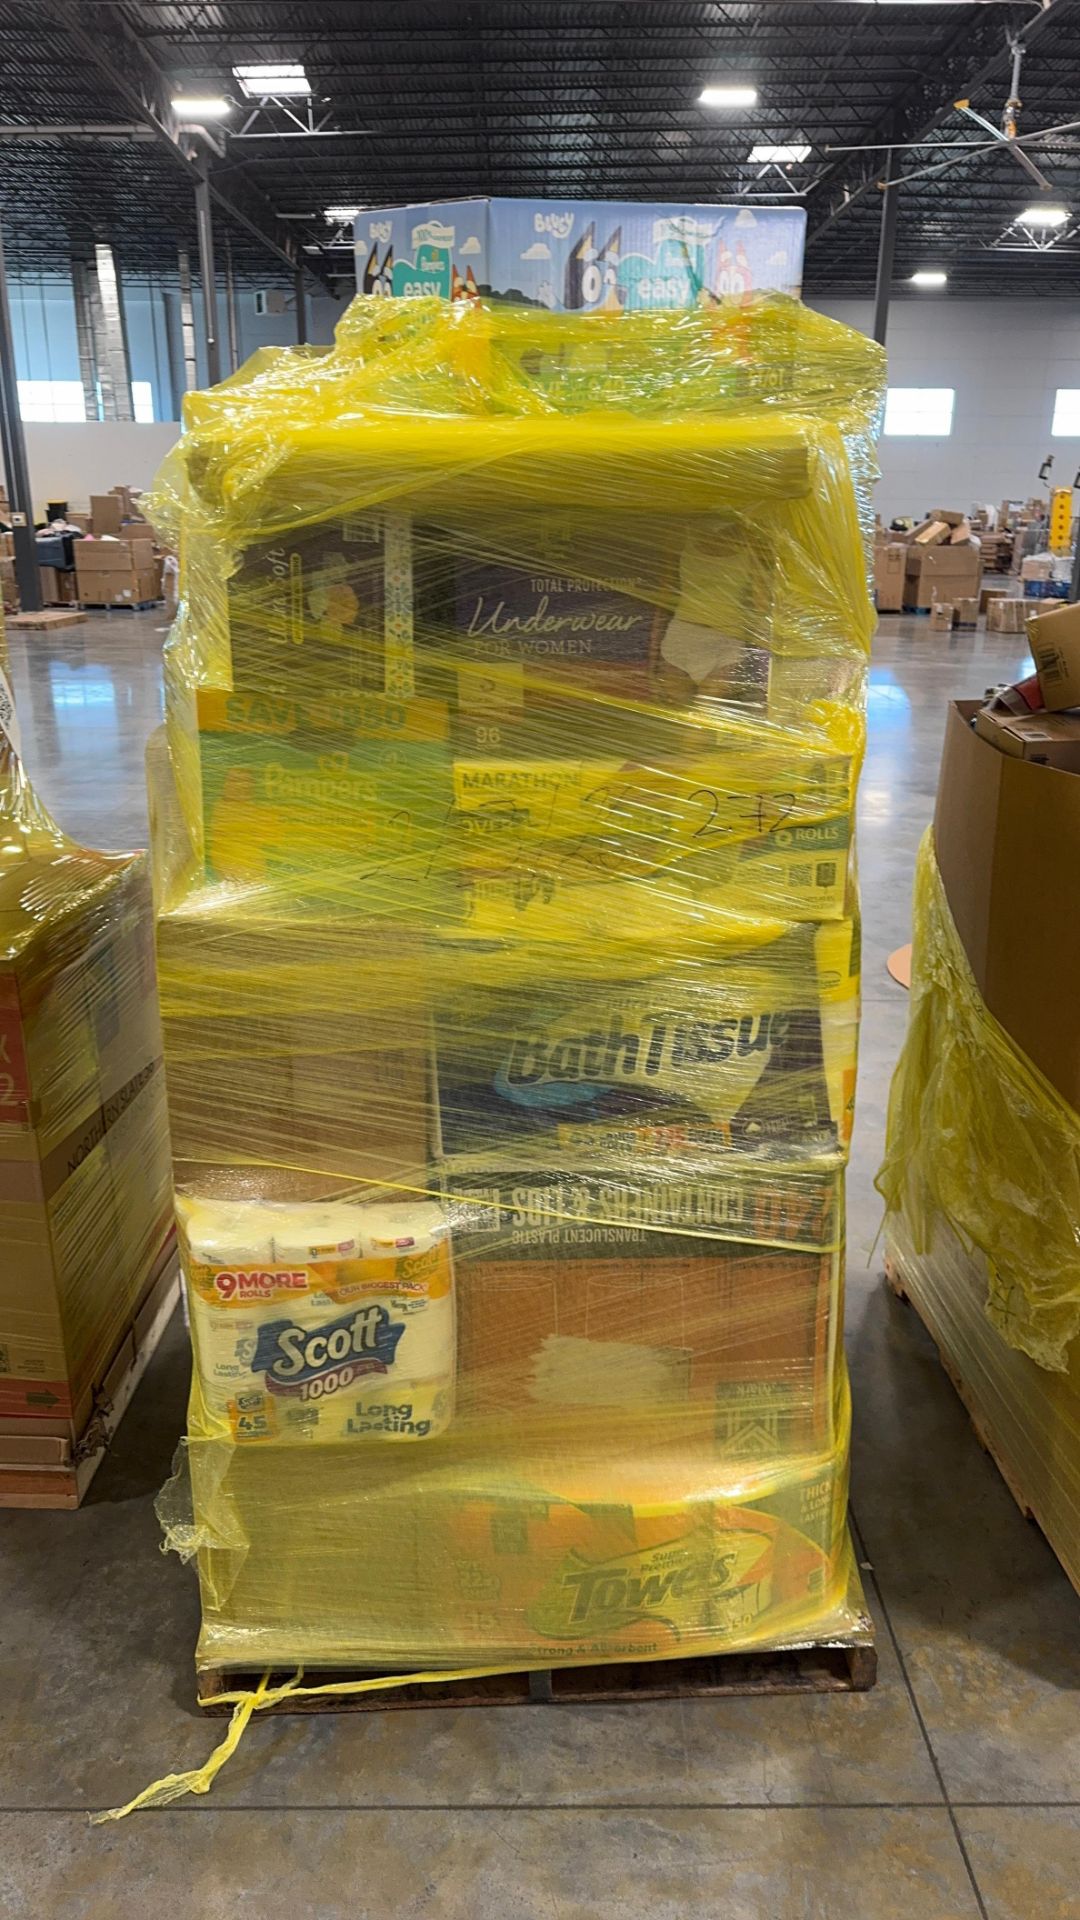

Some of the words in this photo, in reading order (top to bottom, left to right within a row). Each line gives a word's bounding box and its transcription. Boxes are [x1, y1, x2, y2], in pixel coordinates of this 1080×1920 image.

[637, 277, 692, 305] easy
[531, 578, 563, 592] TOTAL
[467, 595, 643, 637] Underwear
[474, 640, 511, 655] FOR
[517, 639, 592, 654] WOMEN
[475, 727, 501, 743] 96
[264, 763, 378, 800] Pampers
[462, 773, 580, 789] MARATHON
[796, 825, 838, 840] ROLLS
[511, 1187, 566, 1227] LIDS
[599, 1188, 746, 1225] CONTAINERS
[512, 1229, 560, 1245] PLASTIC
[564, 1228, 648, 1245] TRANSLUCENT
[216, 1273, 237, 1299] 9
[238, 1272, 308, 1289] MORE
[240, 1290, 272, 1298] ROLLS
[273, 1305, 382, 1376] Scott
[301, 1367, 355, 1401] 1000
[356, 1402, 412, 1420] Long
[238, 1415, 267, 1430] 45
[347, 1418, 431, 1437] Lasting
[560, 1551, 738, 1623] Towels
[530, 1644, 573, 1656] Strong
[576, 1643, 587, 1654] &
